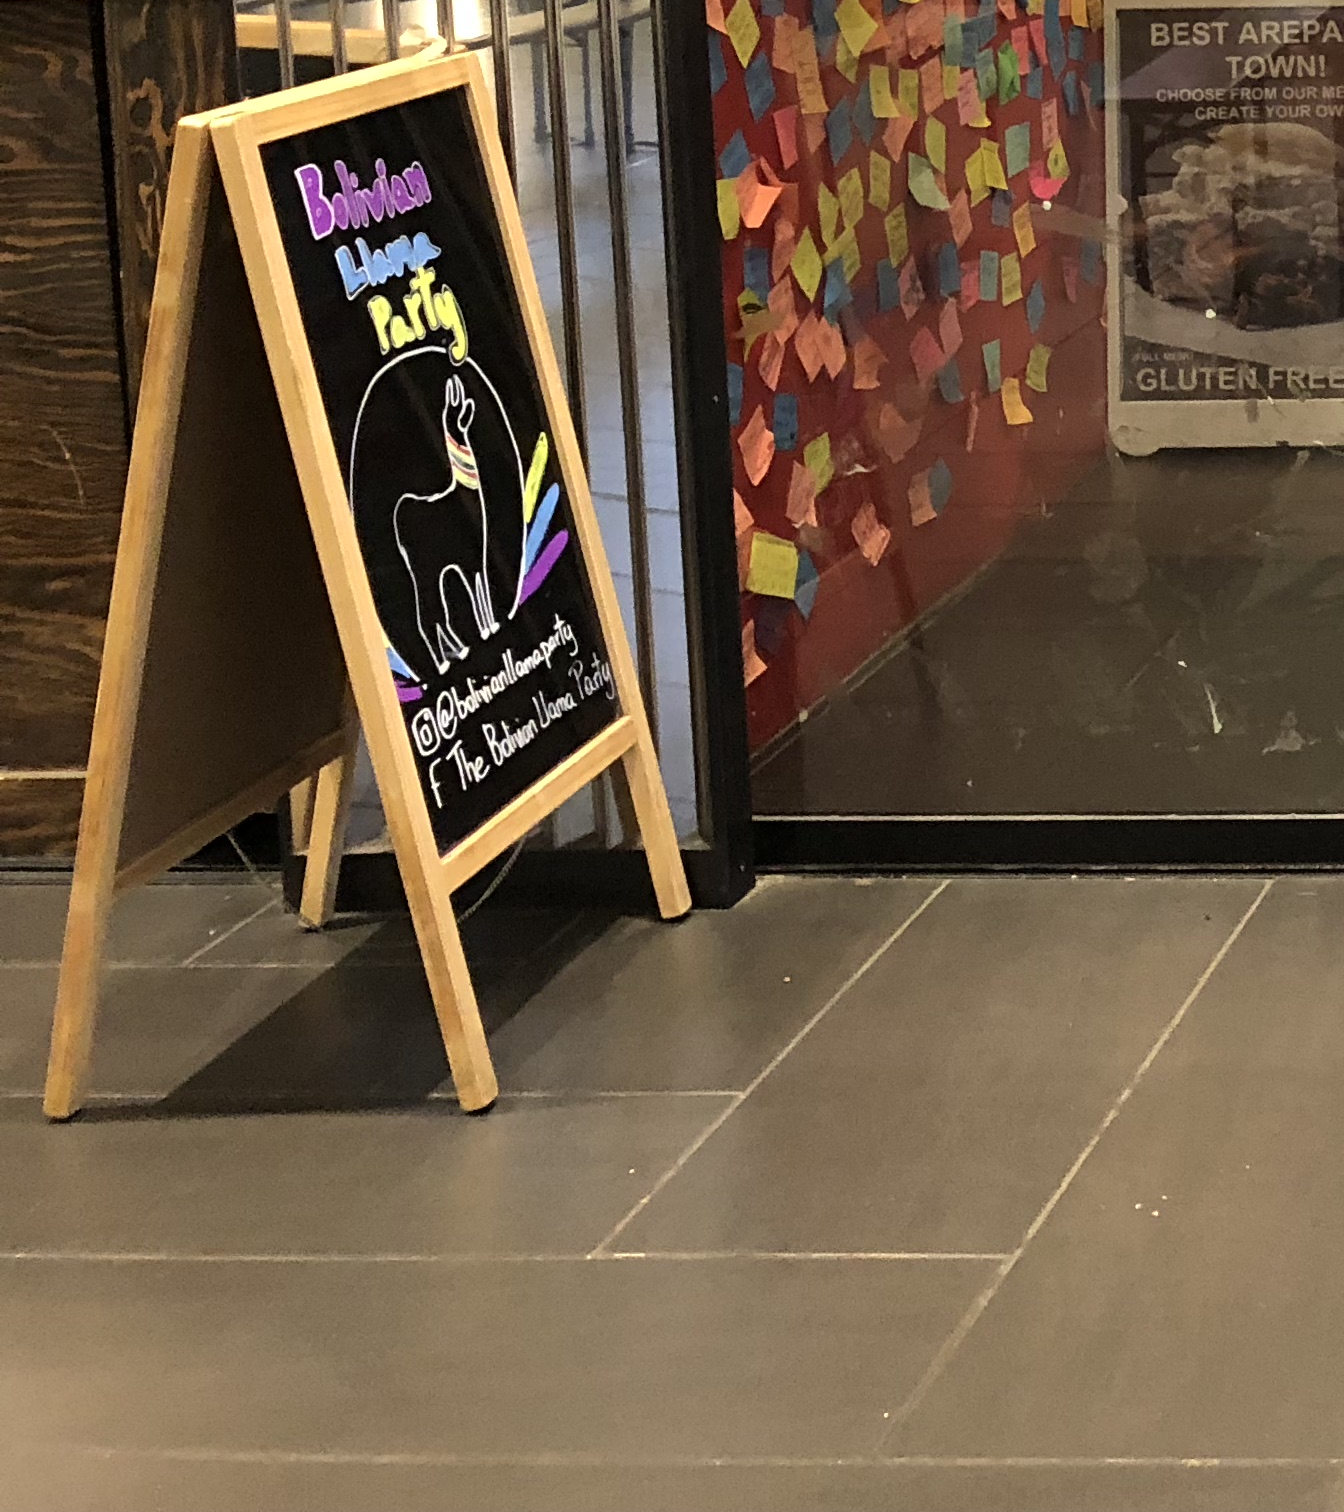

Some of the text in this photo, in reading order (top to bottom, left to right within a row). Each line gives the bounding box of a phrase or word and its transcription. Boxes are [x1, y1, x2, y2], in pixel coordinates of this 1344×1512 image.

[1150, 21, 1229, 47] BEST
[1225, 55, 1326, 80] TOWN!
[1156, 88, 1227, 103] CHOOSE
[1230, 87, 1277, 101] FROM
[1282, 87, 1317, 100] OUR
[1195, 106, 1259, 120] CREATE
[1265, 105, 1312, 118] YOUR
[294, 158, 432, 241] Bolivian
[335, 232, 442, 301] Llama
[367, 266, 469, 366] Party
[1136, 367, 1258, 392] GLUTEN
[436, 613, 579, 739] @bolivianllamaparty
[446, 740, 490, 791] The
[482, 717, 539, 766] Bolivian
[567, 652, 616, 700] Party
